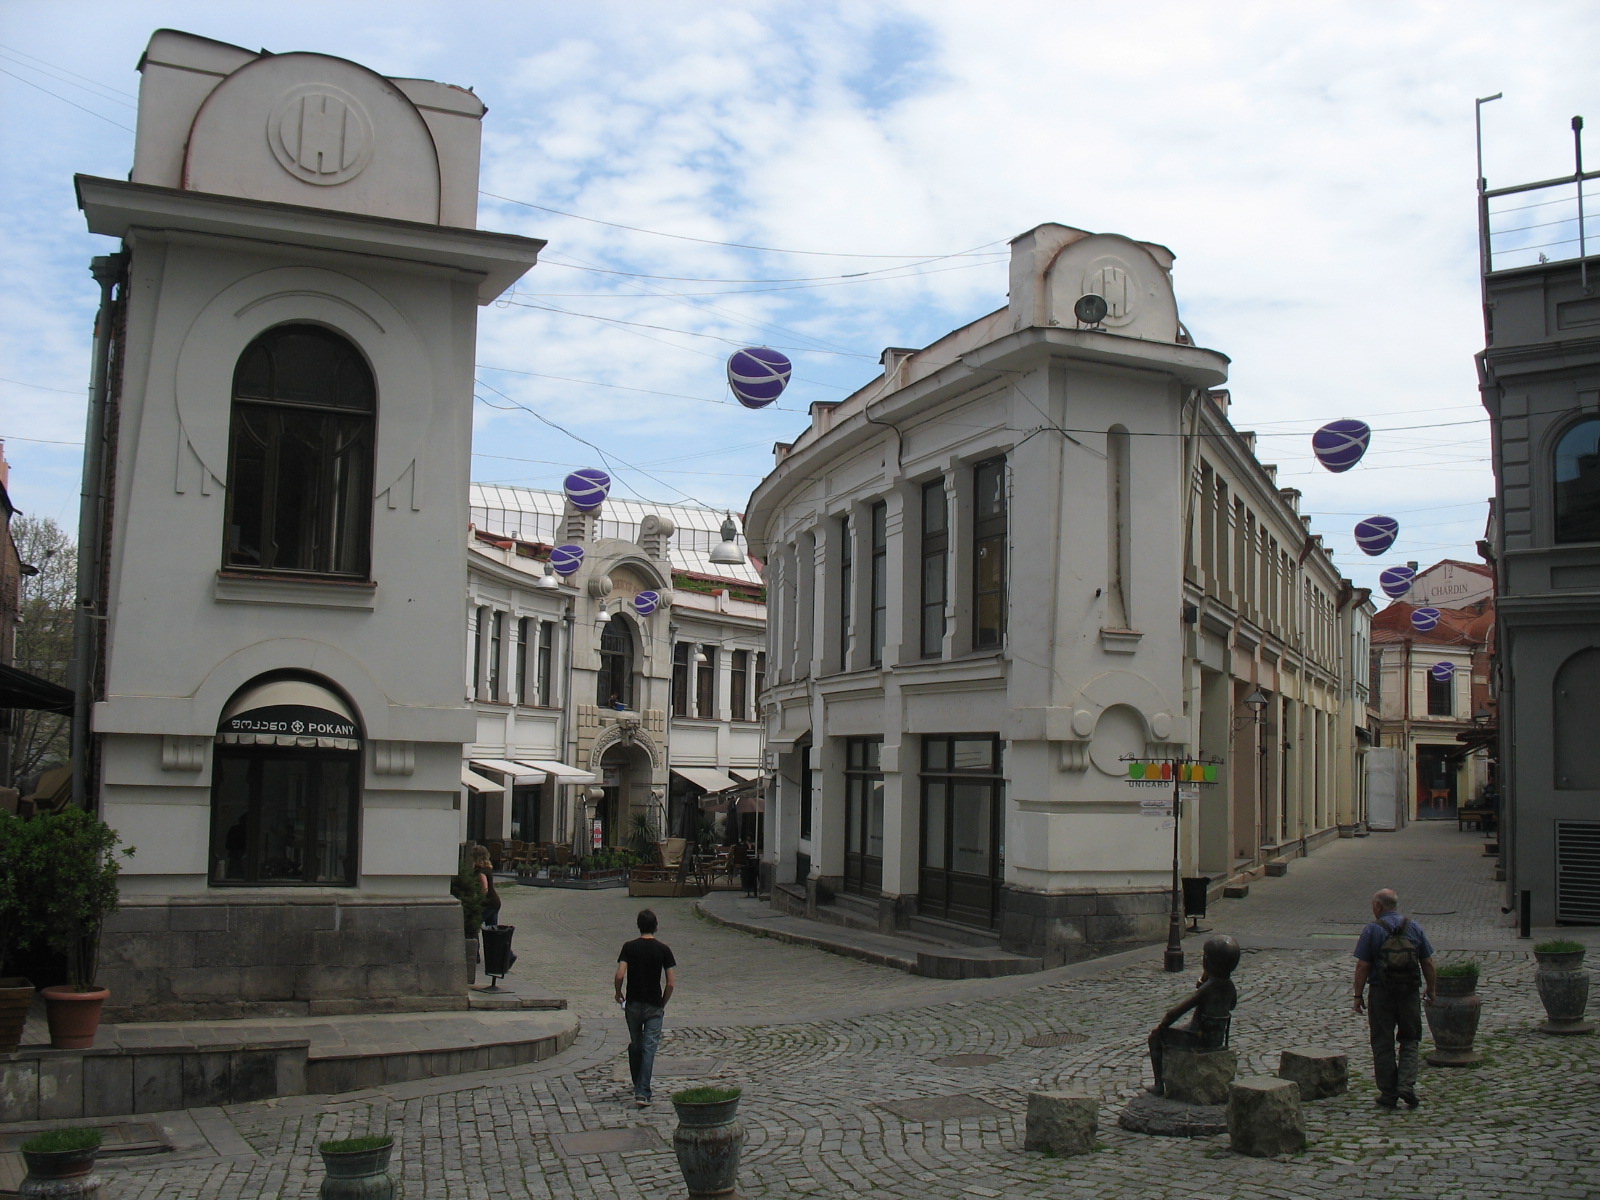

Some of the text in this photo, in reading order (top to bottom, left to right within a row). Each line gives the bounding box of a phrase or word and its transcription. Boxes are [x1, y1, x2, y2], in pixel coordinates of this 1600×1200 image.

[1444, 564, 1454, 579] 12
[1431, 584, 1468, 597] CHARDIN
[308, 722, 355, 736] POKANY
